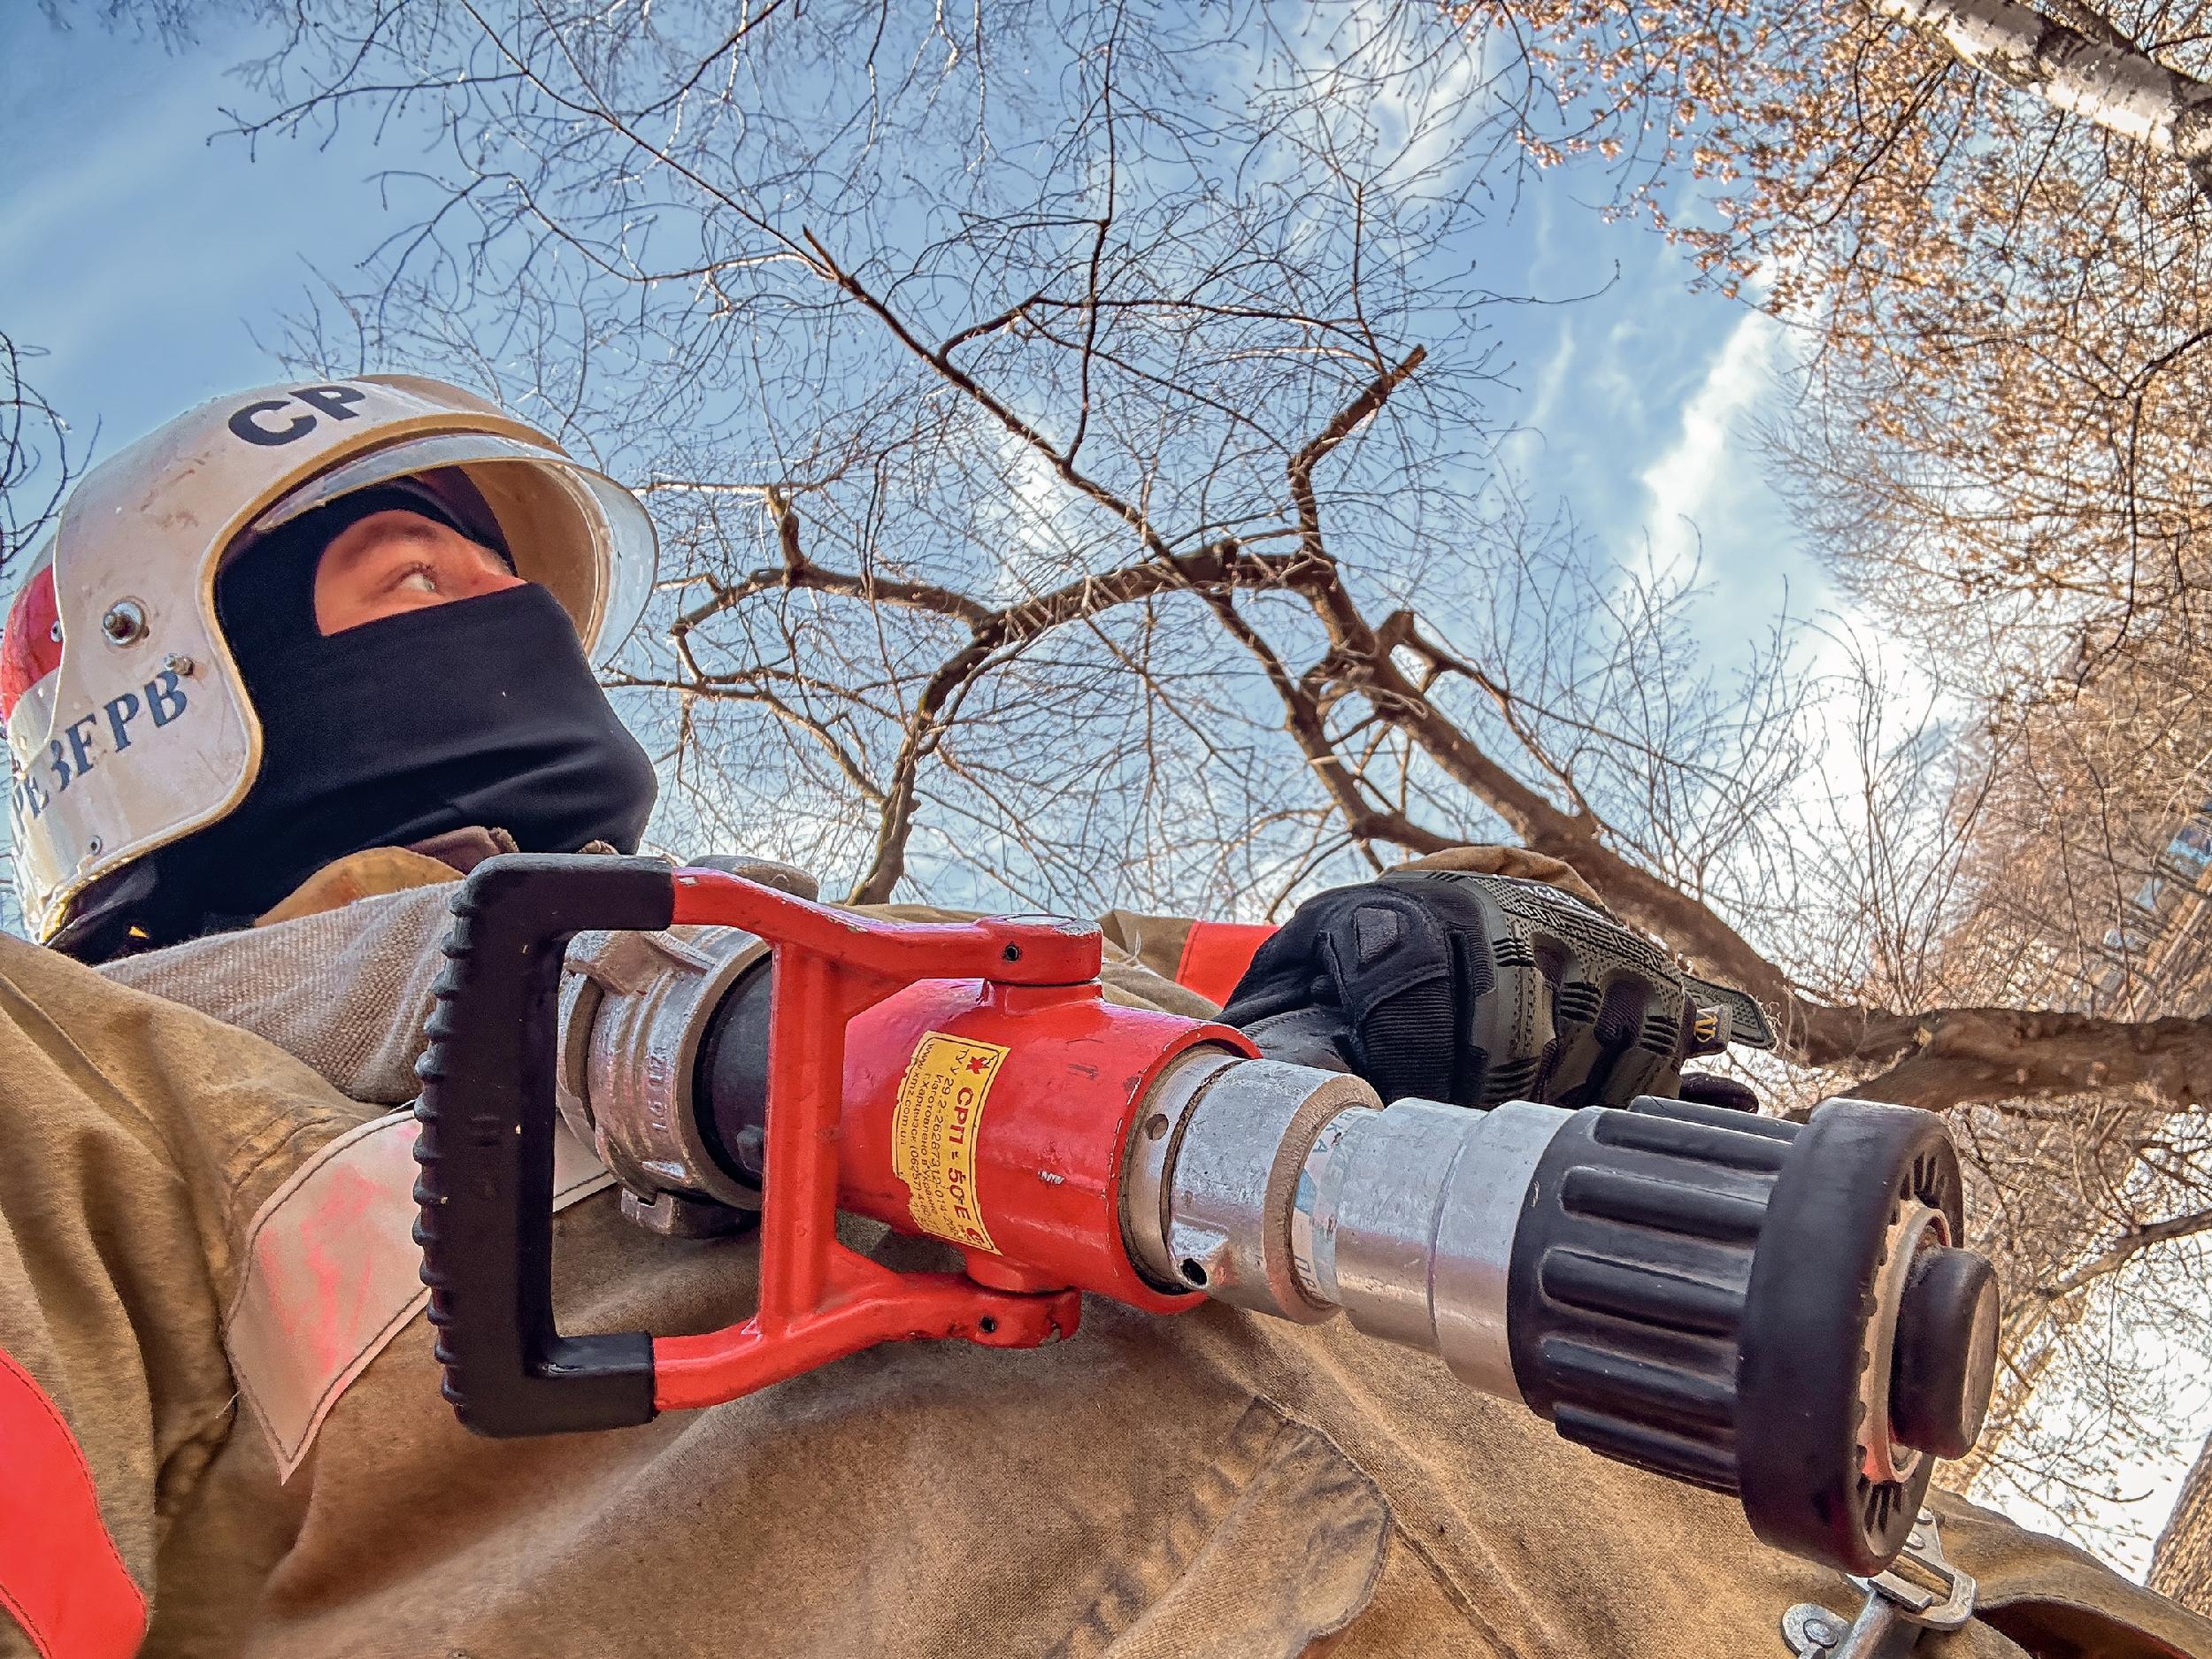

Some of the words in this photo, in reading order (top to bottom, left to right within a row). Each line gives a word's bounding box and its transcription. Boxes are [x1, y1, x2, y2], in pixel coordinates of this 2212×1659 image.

[900, 1043, 935, 1145] www.xmz.com.ua
[920, 1074, 944, 1156] Изготовлено
[949, 1087, 974, 1144] СРП
